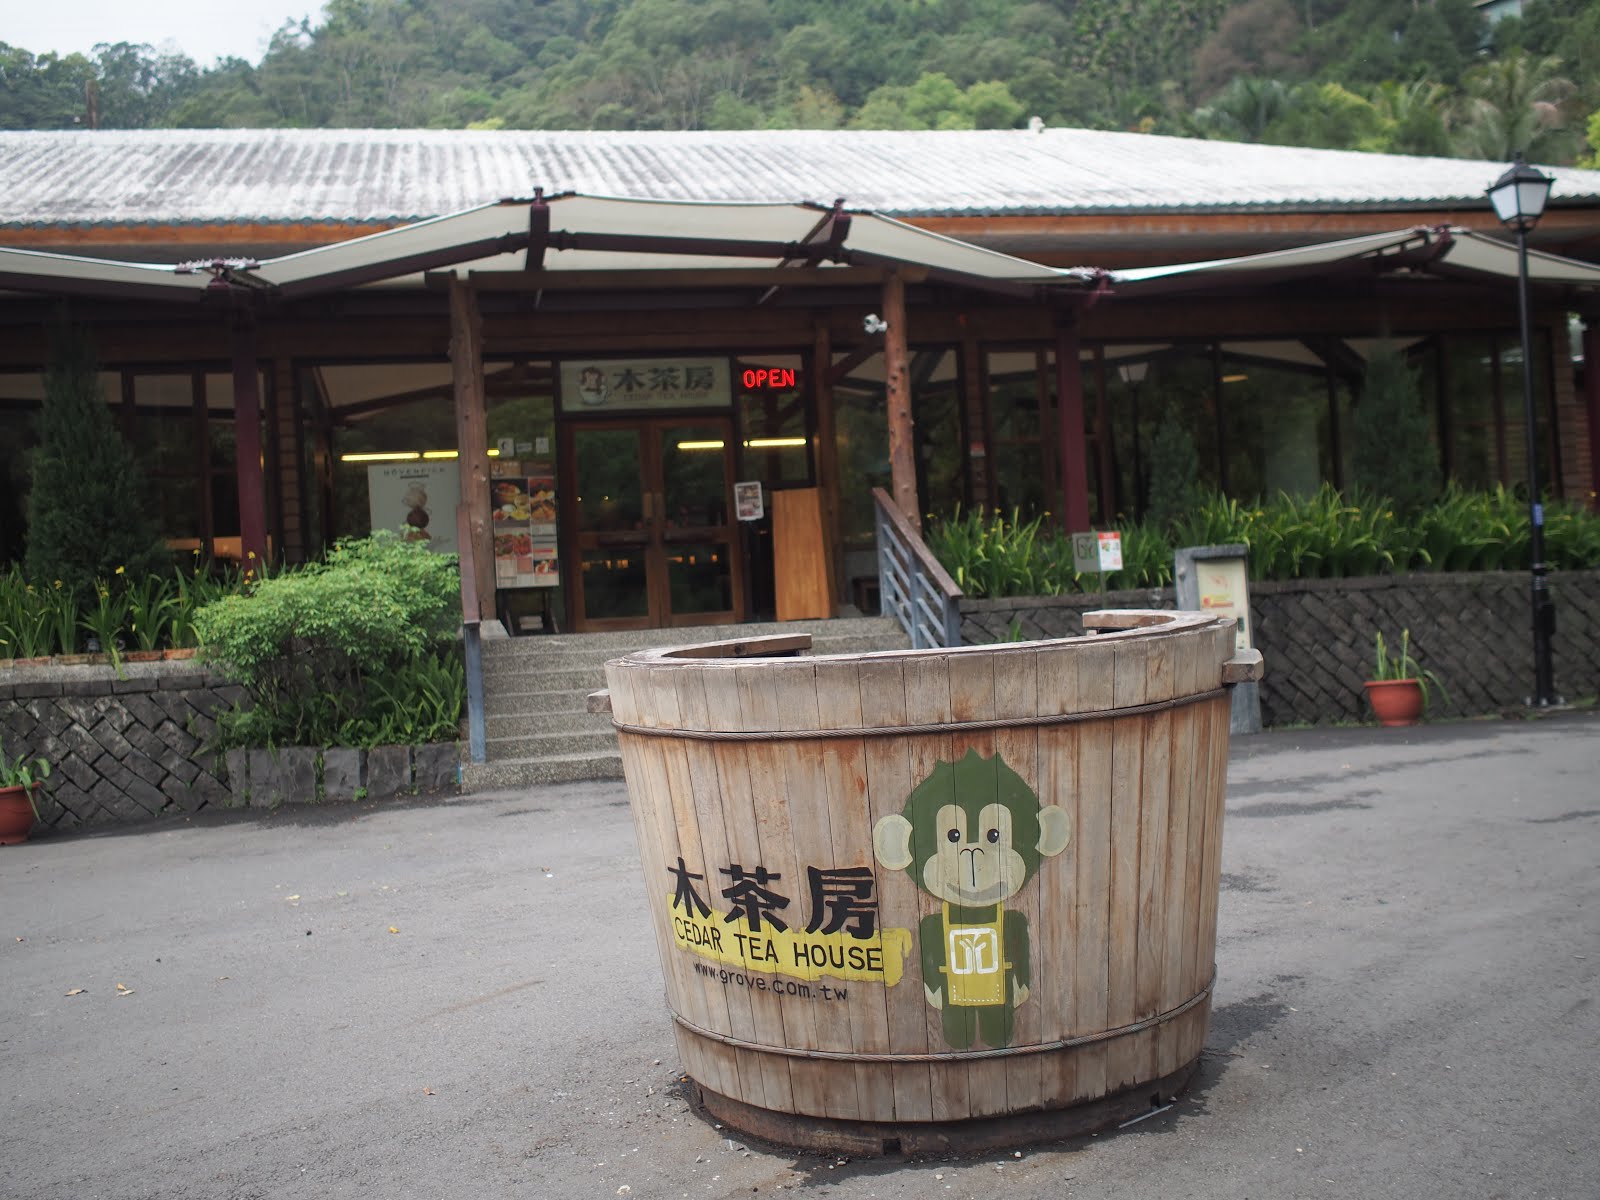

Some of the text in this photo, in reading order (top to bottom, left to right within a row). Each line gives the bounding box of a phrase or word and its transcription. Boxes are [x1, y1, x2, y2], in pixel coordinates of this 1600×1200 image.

[612, 366, 714, 392] 木茶房
[743, 368, 795, 388] OPEN
[667, 857, 878, 939] 木茶房
[674, 916, 884, 972] CEDAR TEA HOUSE
[693, 962, 848, 1001] www.grove.com.tw
